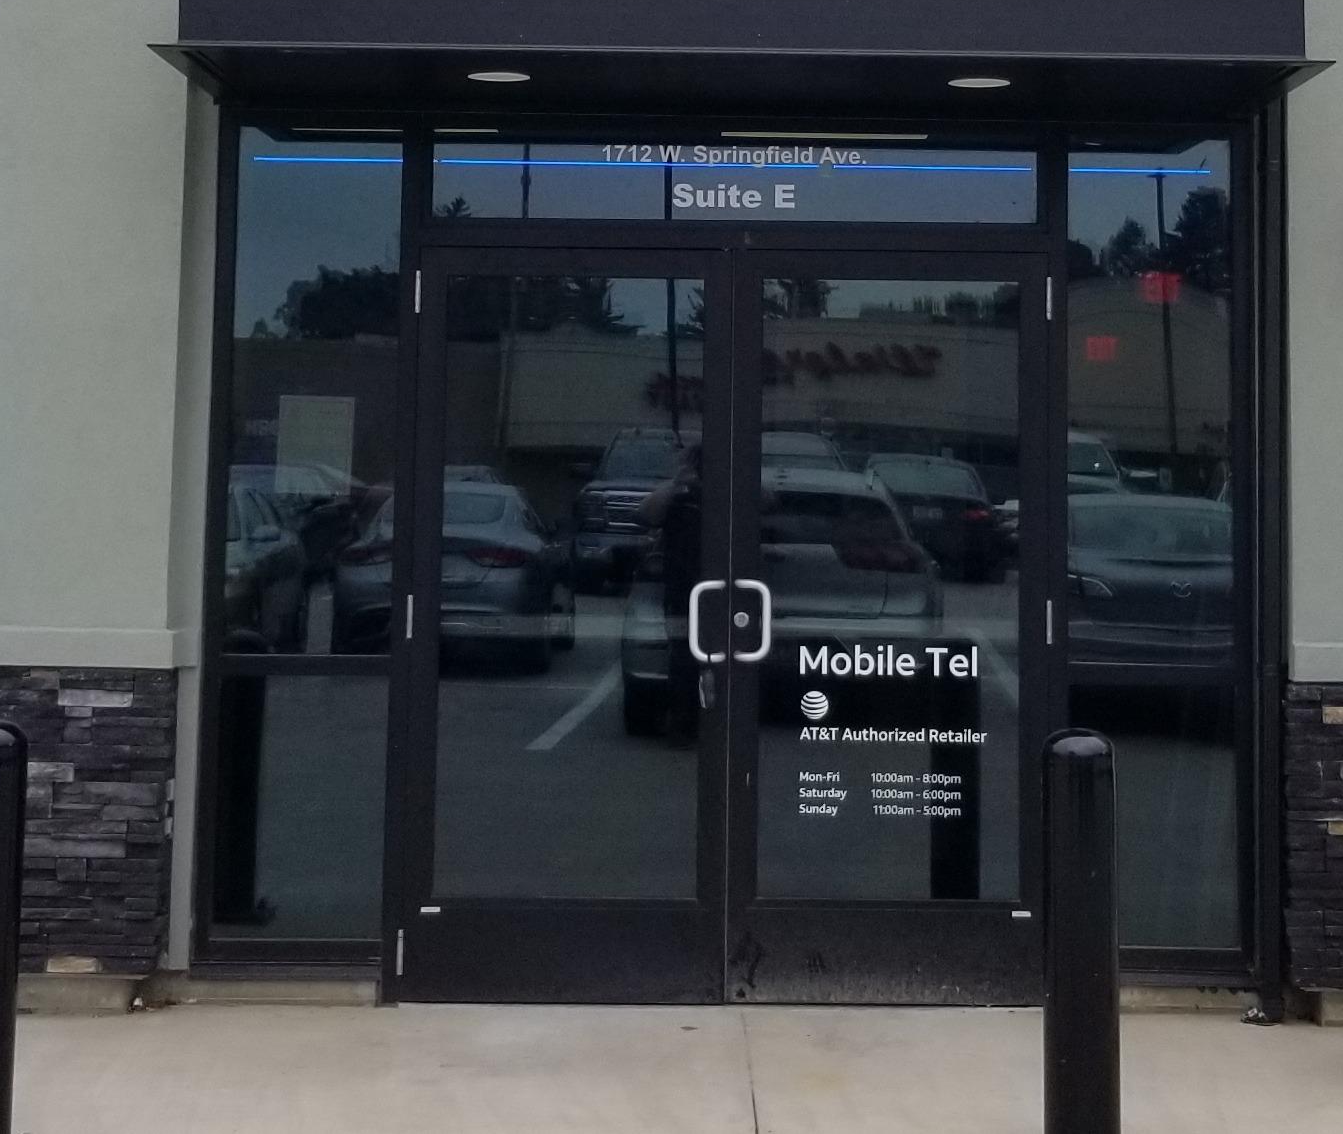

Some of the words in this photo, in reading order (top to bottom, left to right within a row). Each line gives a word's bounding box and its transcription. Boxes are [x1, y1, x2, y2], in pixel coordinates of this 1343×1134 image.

[602, 145, 651, 163] 1712
[660, 145, 685, 163] W.
[693, 146, 813, 168] Springfield
[820, 148, 867, 165] Ave.
[672, 183, 762, 208] Suite
[774, 185, 795, 208] E
[799, 644, 916, 676] Mobile
[925, 646, 978, 677] Tel
[799, 727, 839, 741] AT&T
[842, 728, 925, 743] Authorized
[928, 729, 988, 743] Retailer
[799, 771, 840, 783] Mon-Fri
[870, 772, 914, 784] 10:00am
[922, 773, 962, 787] 8:00pm
[799, 787, 847, 801] Saturday
[870, 788, 914, 800] 10:00am
[922, 789, 962, 803] 6:00pm
[798, 803, 838, 817] Sunday
[872, 804, 914, 816] 11:00am
[923, 805, 962, 819] 5:00pm
